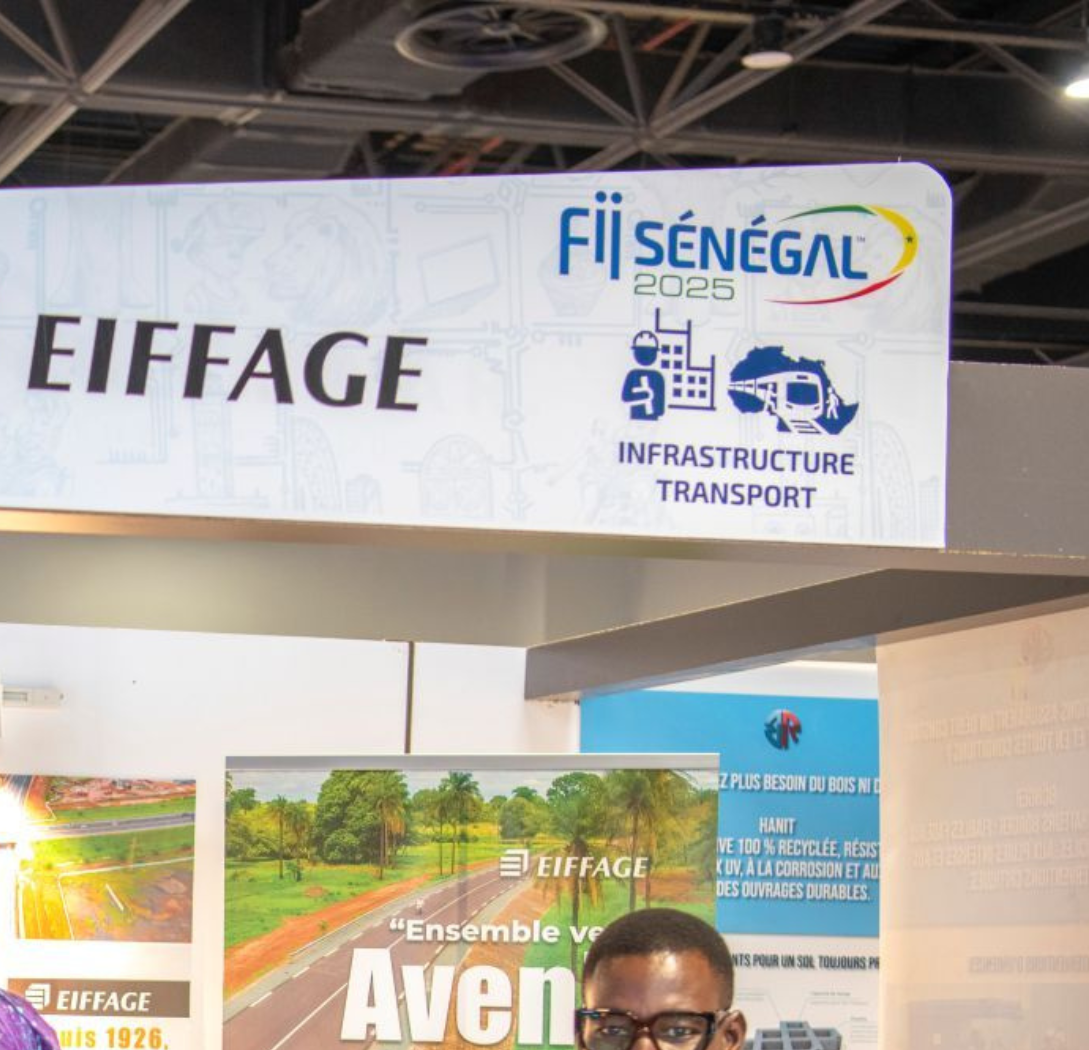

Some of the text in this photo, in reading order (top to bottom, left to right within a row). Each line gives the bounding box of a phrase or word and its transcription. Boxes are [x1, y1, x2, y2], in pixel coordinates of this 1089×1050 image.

[634, 209, 869, 280] SÉNÉGAL
[634, 273, 736, 301] 2025
[27, 314, 429, 411] EIFFAGE
[617, 440, 856, 475] INFRASTRUCTURE
[656, 479, 817, 509] TRANSPORT
[731, 772, 761, 790] PLUS
[763, 773, 807, 792] BESOIN
[809, 775, 825, 792] DU
[828, 776, 856, 794] BOIS
[858, 777, 871, 794] NI
[759, 817, 797, 835] HANIT
[739, 838, 761, 855] 100
[763, 838, 776, 855] %
[779, 837, 841, 859] RECYCLÉE,
[537, 856, 649, 879] EIFFAGE
[725, 858, 744, 878] UV,
[746, 857, 755, 876] À
[757, 860, 773, 876] LA
[776, 861, 843, 878] CORROSION
[845, 862, 860, 878] ET
[716, 880, 871, 902] DES OUVRAGES DURABLES.
[753, 954, 779, 968] POUR
[781, 954, 795, 968] UN
[797, 955, 815, 969] SOL
[819, 956, 866, 970] TOUJOURS
[56, 990, 153, 1012] EIFFAGE
